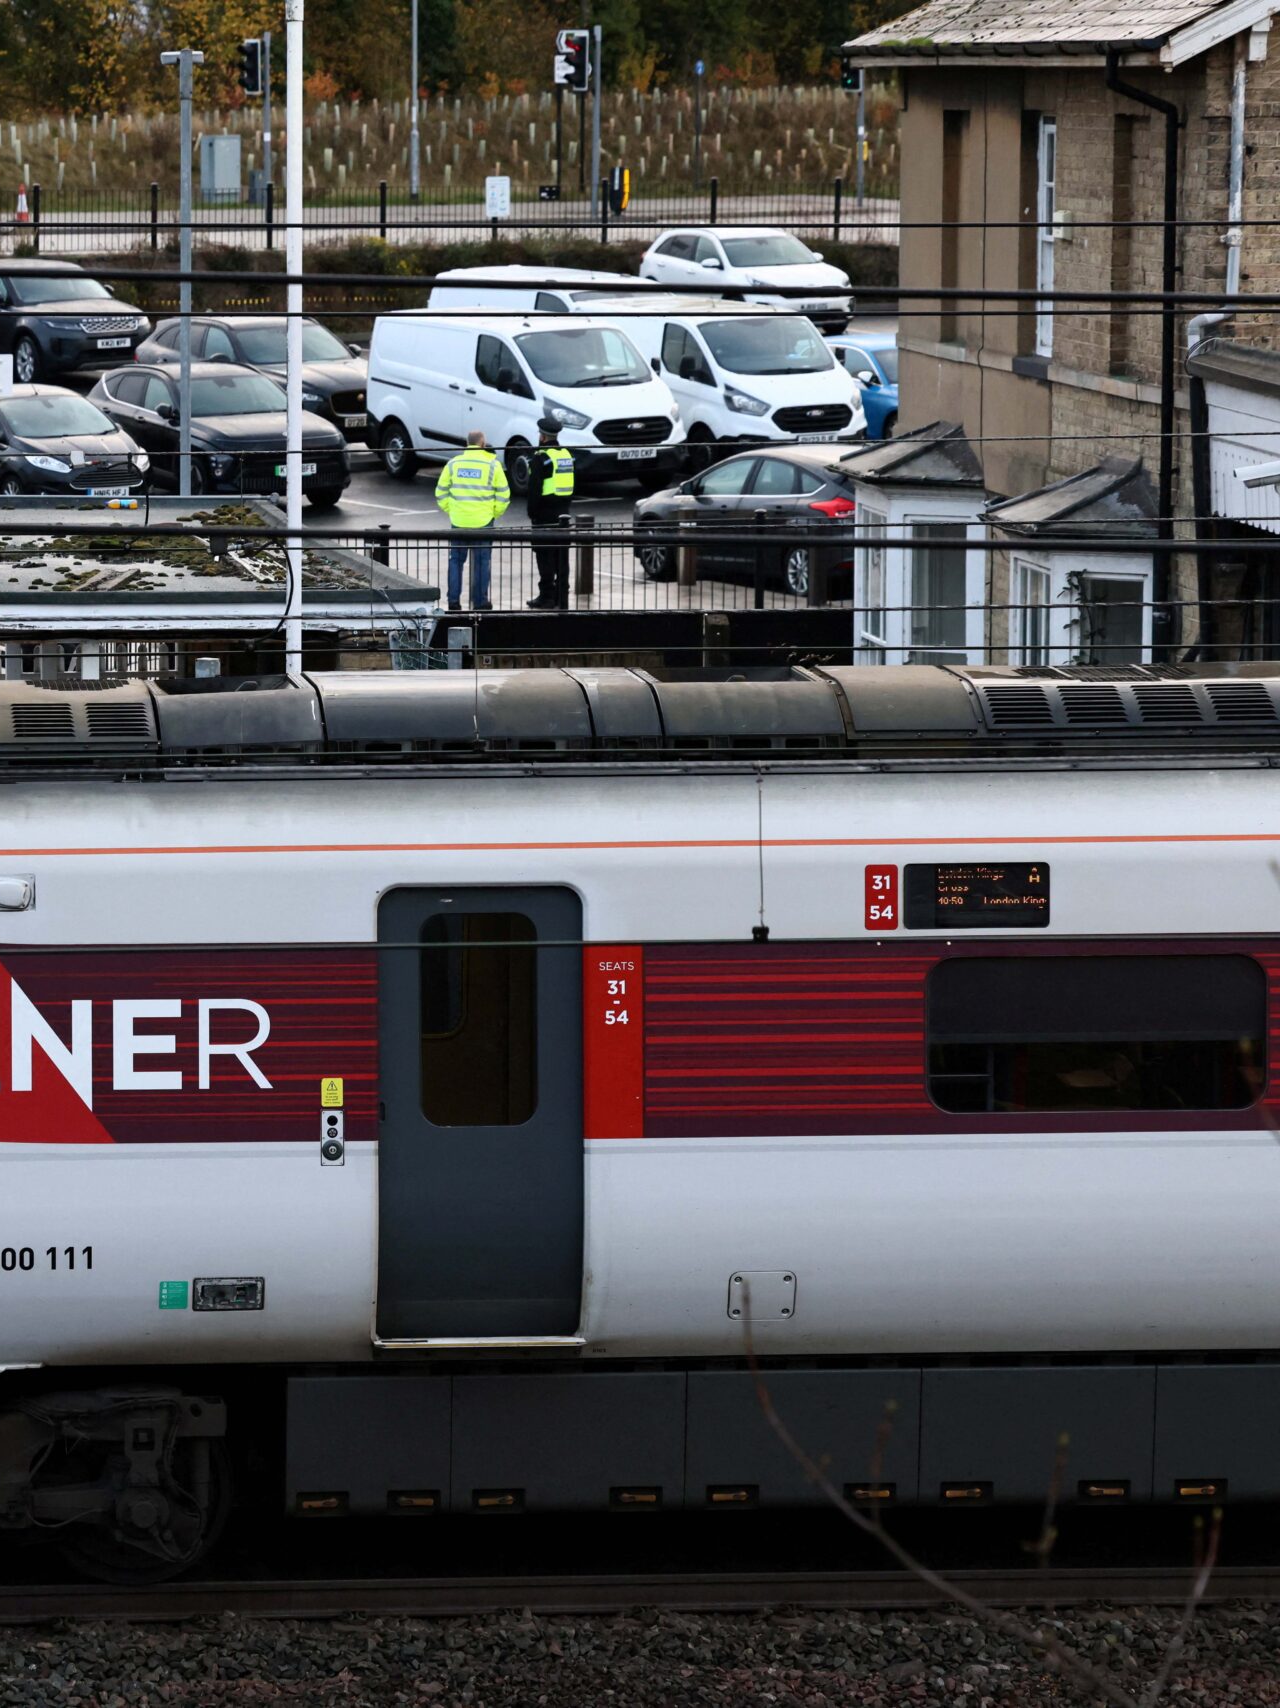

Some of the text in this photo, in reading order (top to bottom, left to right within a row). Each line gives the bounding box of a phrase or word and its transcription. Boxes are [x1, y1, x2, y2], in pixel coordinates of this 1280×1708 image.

[457, 469, 481, 478] POLICE
[872, 875, 891, 890] 31
[983, 896, 1020, 905] London
[869, 905, 894, 920] 54
[598, 961, 635, 971] SEATS
[607, 980, 626, 995] 31
[605, 1010, 629, 1025] 54
[46, 1246, 93, 1271] 111
